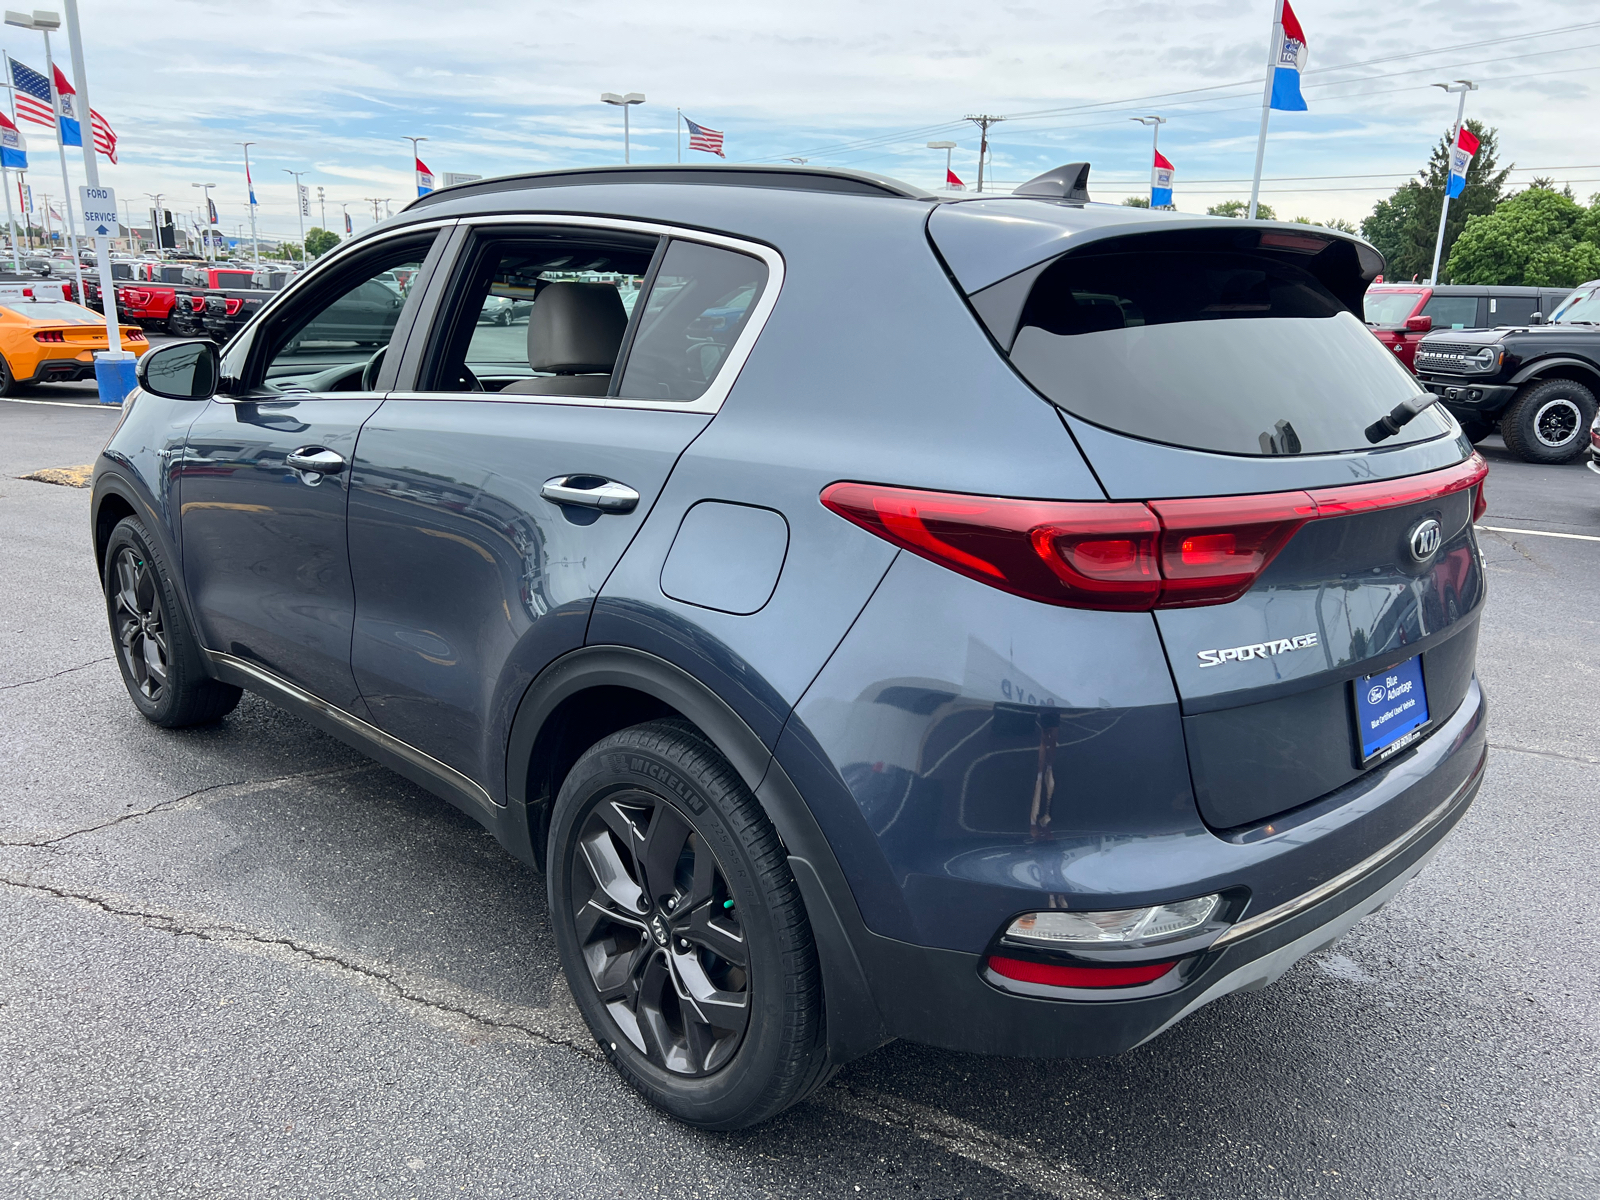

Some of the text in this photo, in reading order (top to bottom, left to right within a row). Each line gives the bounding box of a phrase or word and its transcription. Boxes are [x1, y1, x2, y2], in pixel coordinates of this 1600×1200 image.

[86, 189, 108, 199] FORD
[84, 211, 117, 222] SERVICE
[1423, 352, 1465, 360] BRONCO
[1416, 525, 1440, 556] KIA
[1197, 632, 1319, 668] SPORTAGE
[1385, 675, 1398, 688] Blue
[1387, 680, 1413, 701] Advantage
[1369, 687, 1384, 703] Ford
[1370, 698, 1416, 729] Blue Certified Used Vehicle
[630, 757, 704, 811] MICHELIN
